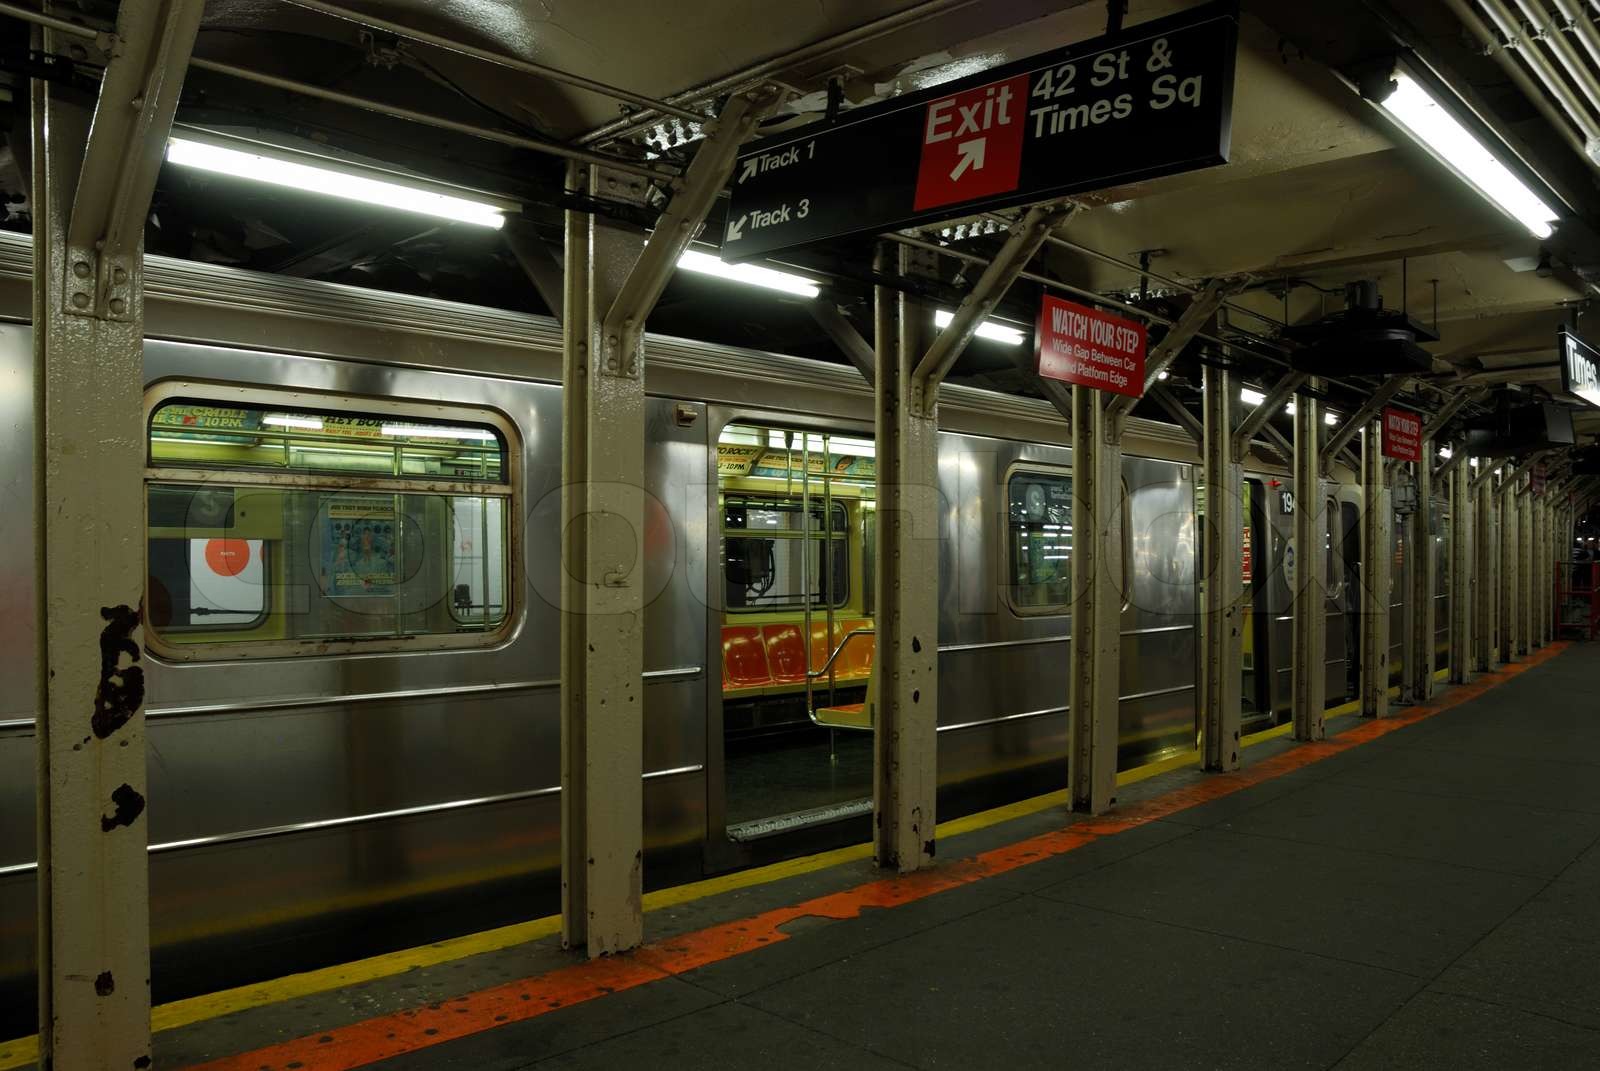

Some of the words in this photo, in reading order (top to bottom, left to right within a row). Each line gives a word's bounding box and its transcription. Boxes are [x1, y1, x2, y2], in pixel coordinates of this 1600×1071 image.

[1031, 63, 1077, 101] 42
[1090, 50, 1130, 88] St
[1147, 37, 1173, 73] &
[925, 87, 1013, 145] Exit
[1029, 91, 1133, 140] Times
[1150, 74, 1203, 111] Sq
[758, 147, 800, 175] Track
[806, 140, 816, 161] 1
[749, 205, 791, 231] Track
[796, 198, 810, 219] 3
[1053, 307, 1088, 341] WATCH
[1089, 317, 1115, 349] YOUR
[1115, 325, 1140, 354] STEP
[1053, 338, 1073, 355] Wide
[1074, 344, 1090, 361] Gap
[1091, 349, 1123, 369] Between
[1123, 357, 1137, 371] Car
[1566, 336, 1597, 390] Times
[1078, 363, 1109, 382] Platform
[1109, 369, 1128, 388] Edge
[191, 408, 247, 420] CRADLE
